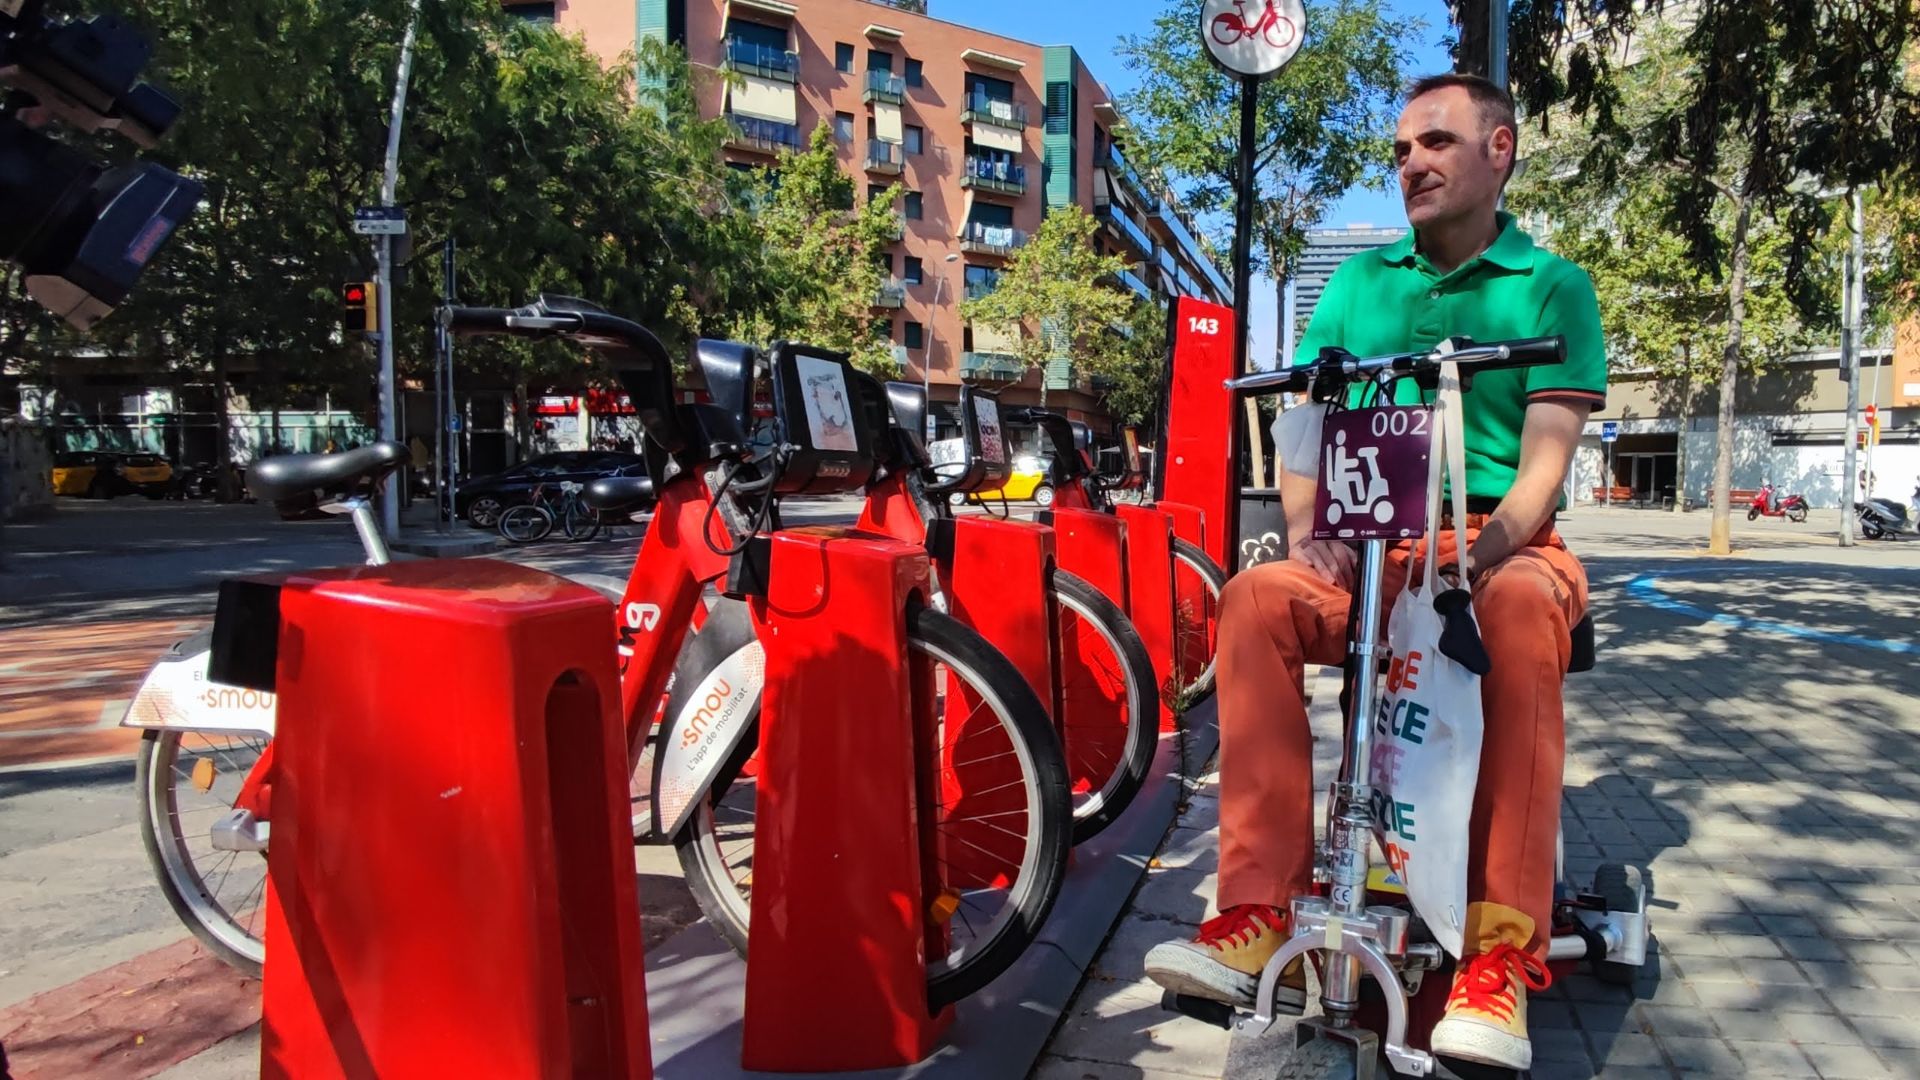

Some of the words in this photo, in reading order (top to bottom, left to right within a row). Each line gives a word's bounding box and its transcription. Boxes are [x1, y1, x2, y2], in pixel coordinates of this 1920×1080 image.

[1189, 317, 1219, 335] 143
[1372, 410, 1429, 437] 002
[207, 689, 273, 709] smou
[683, 678, 732, 745] smou
[687, 745, 708, 771] L'app
[707, 731, 717, 745] de
[715, 687, 748, 731] mobilitat
